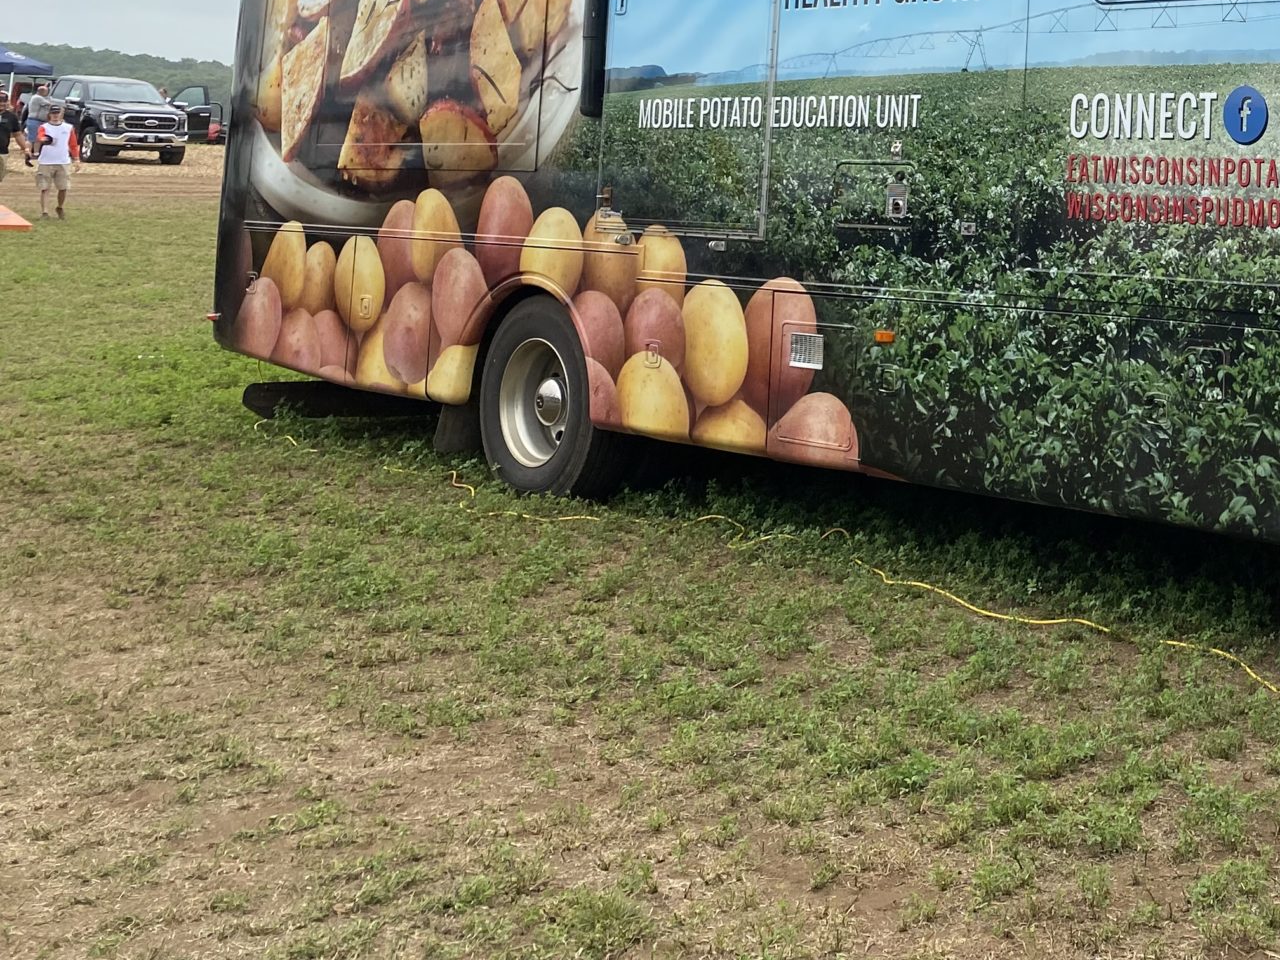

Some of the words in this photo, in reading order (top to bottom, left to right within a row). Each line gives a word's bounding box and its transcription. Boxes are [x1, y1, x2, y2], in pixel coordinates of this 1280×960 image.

[638, 96, 694, 129] MOBILE
[699, 95, 762, 128] POTATO
[770, 94, 870, 129] EDUCATION
[876, 93, 922, 128] UNIT
[1069, 92, 1218, 140] CONNECT
